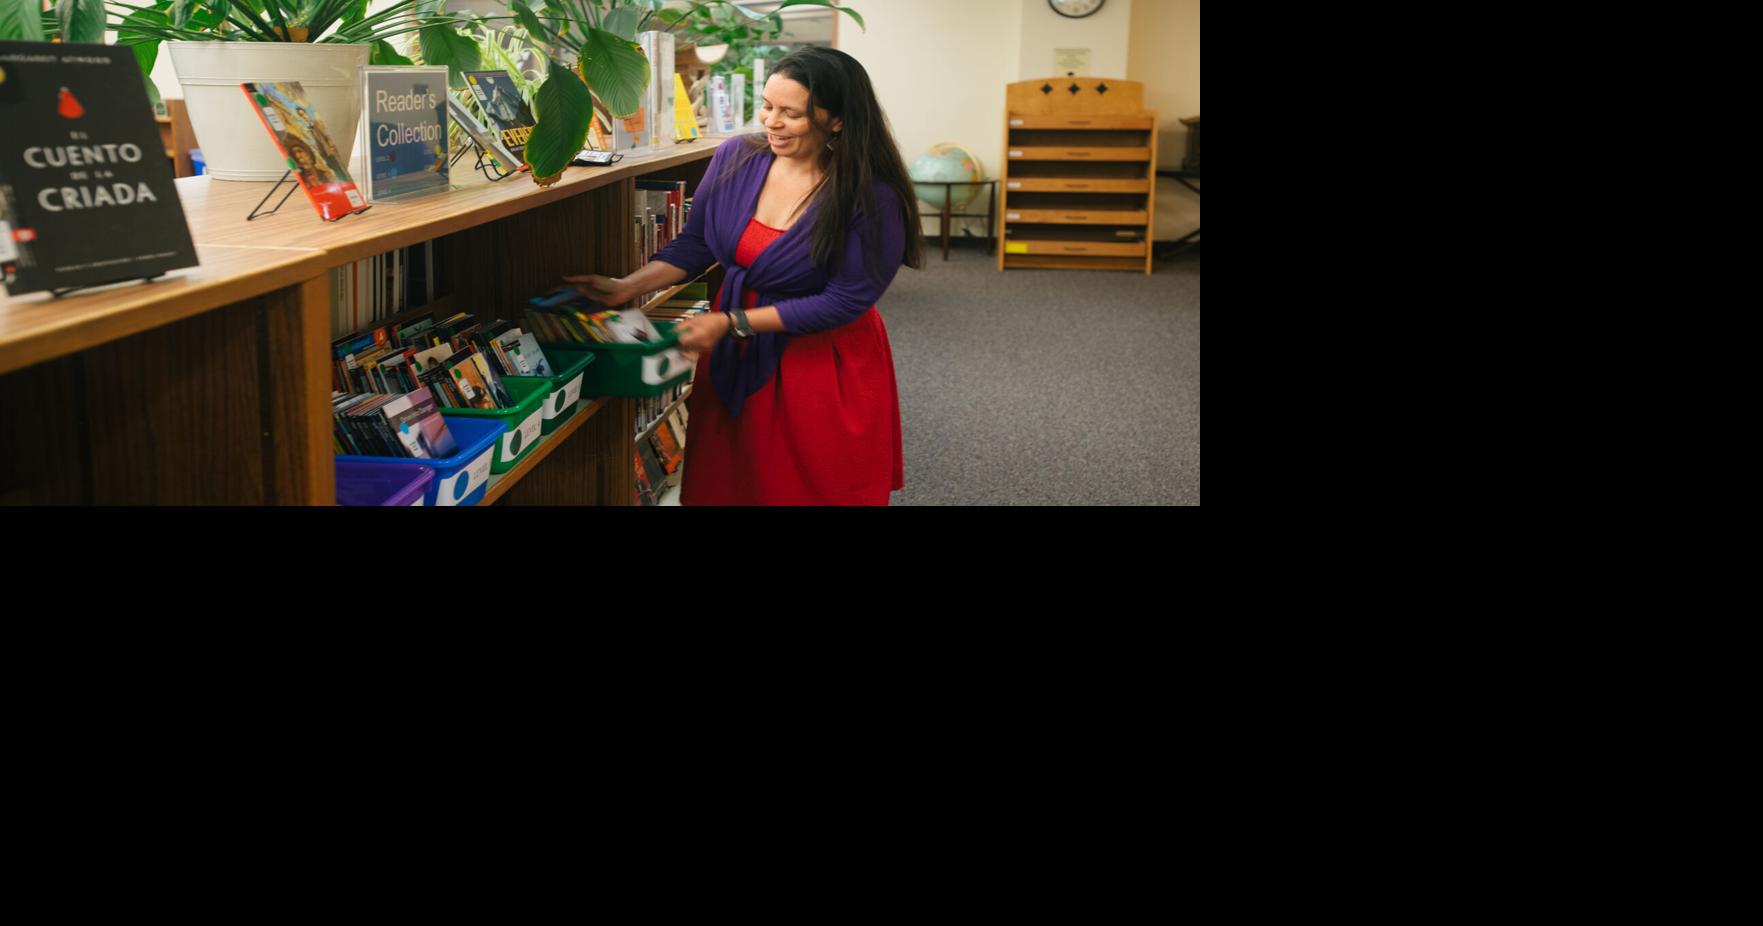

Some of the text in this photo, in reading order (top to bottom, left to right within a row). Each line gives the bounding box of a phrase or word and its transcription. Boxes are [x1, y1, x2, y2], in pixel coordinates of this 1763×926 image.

[376, 88, 437, 113] Reader's
[377, 121, 442, 147] Collection
[23, 143, 142, 168] CUENTO
[37, 182, 157, 211] CRIADA
